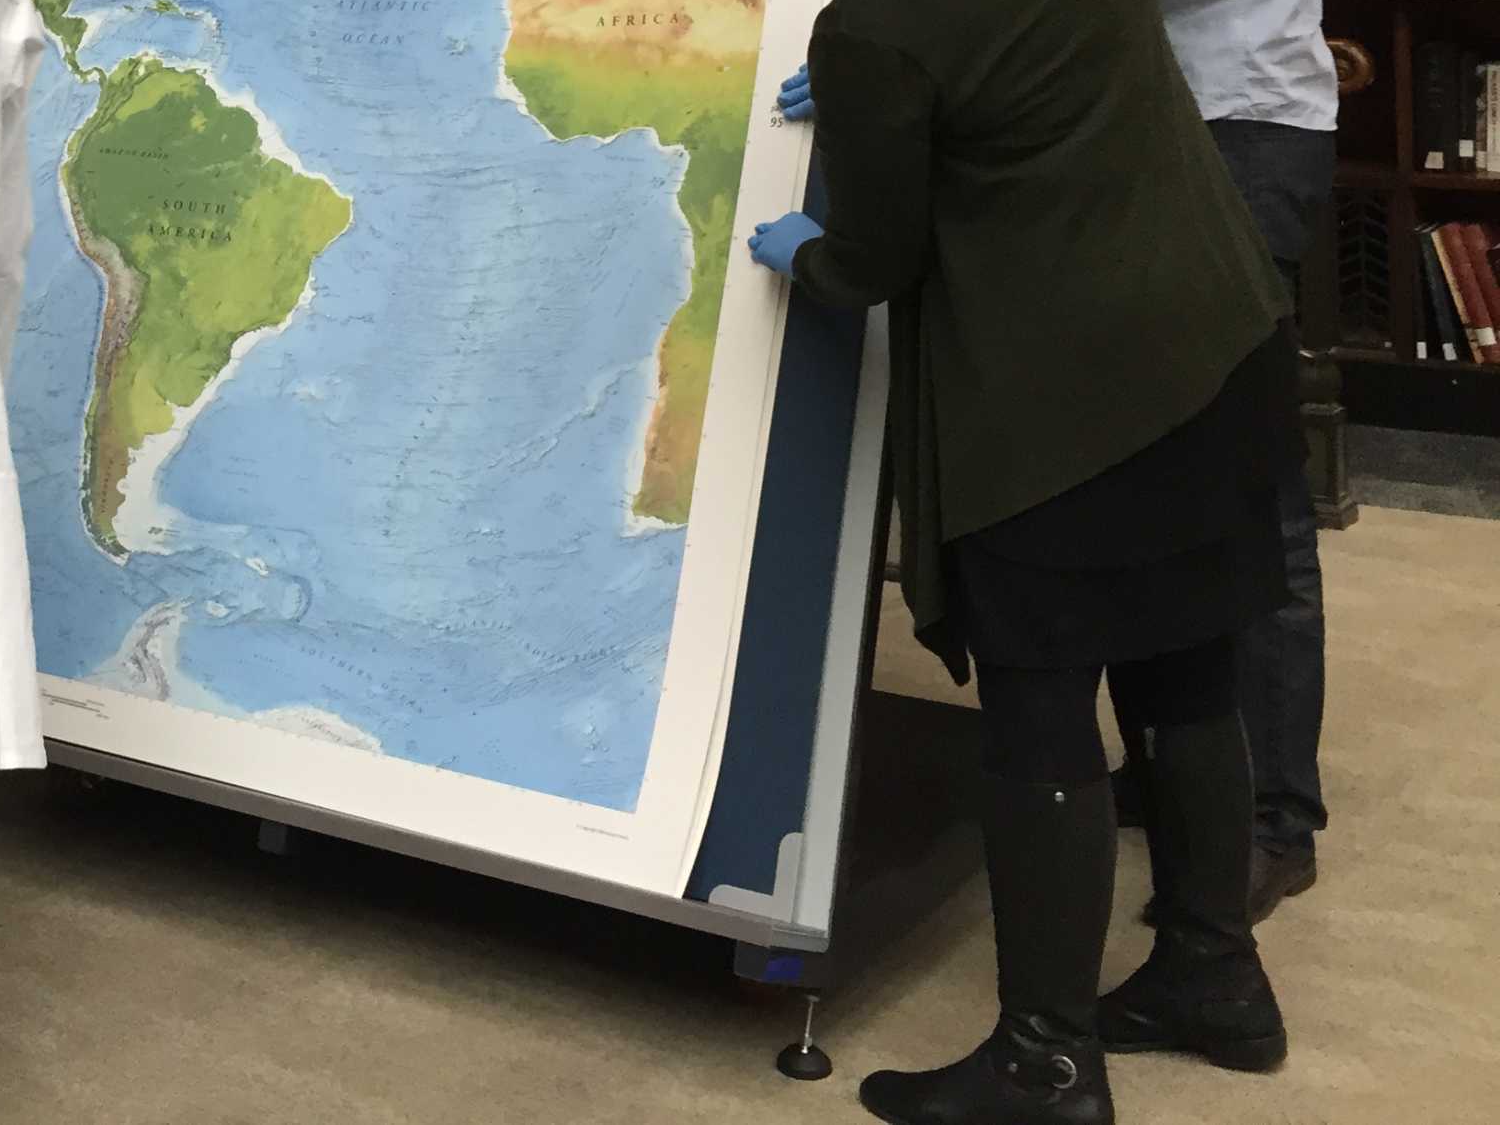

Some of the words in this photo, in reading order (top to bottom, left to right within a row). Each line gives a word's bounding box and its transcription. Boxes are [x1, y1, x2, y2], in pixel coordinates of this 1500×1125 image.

[337, 0, 433, 12] ATLANTIC
[596, 13, 680, 27] AFRICA
[341, 32, 405, 45] OCEAN
[161, 197, 227, 215] SOUTH
[148, 223, 233, 242] AMERICA
